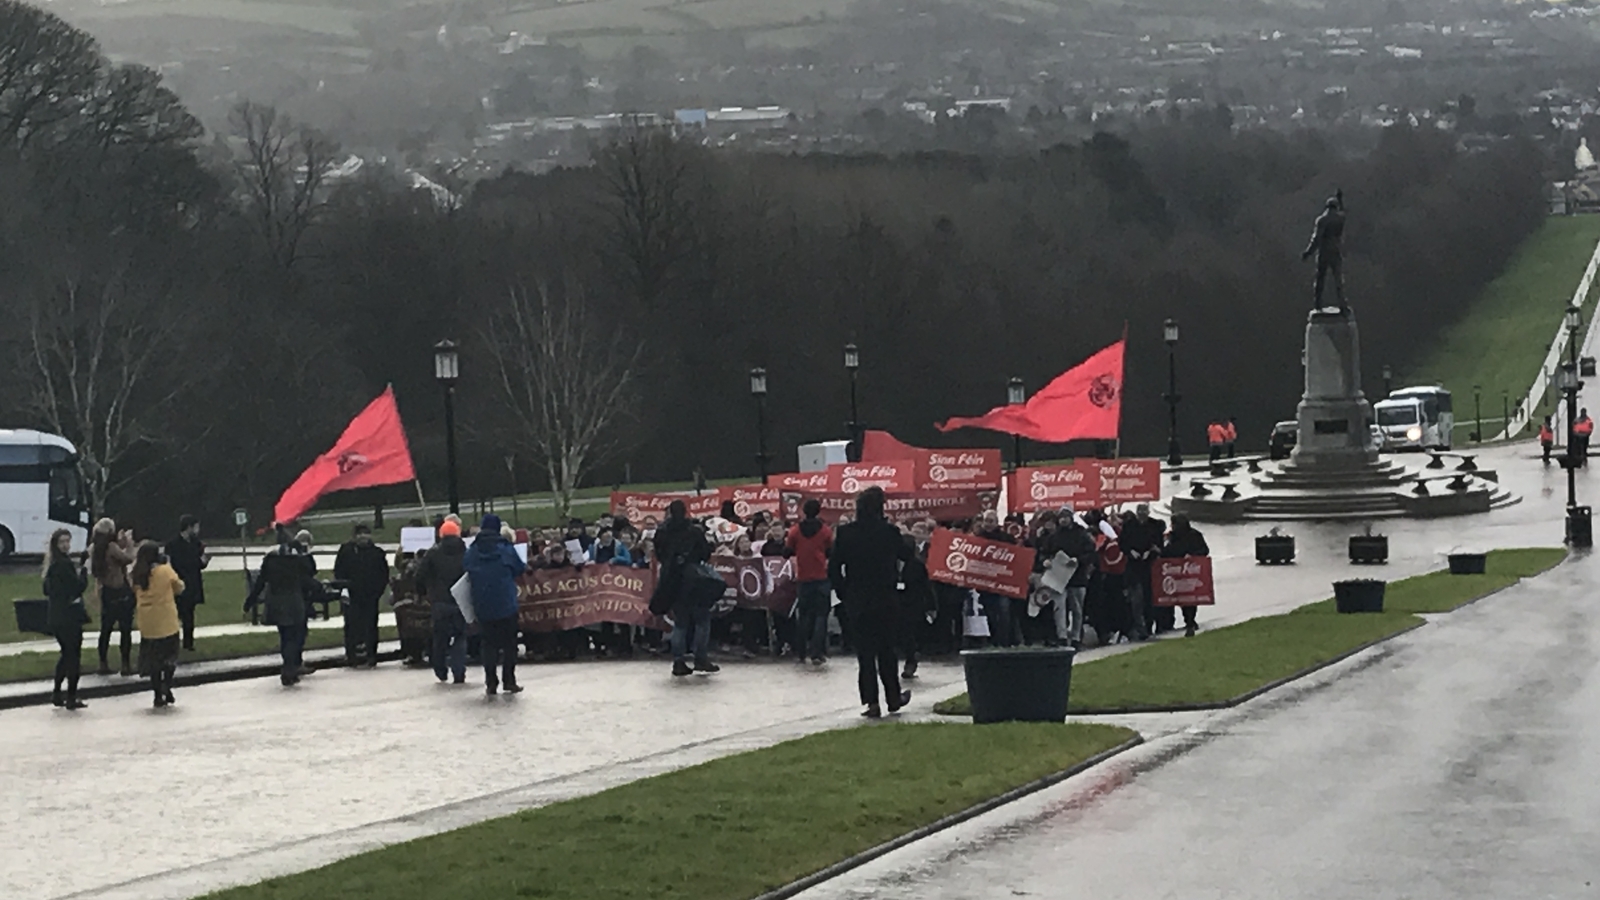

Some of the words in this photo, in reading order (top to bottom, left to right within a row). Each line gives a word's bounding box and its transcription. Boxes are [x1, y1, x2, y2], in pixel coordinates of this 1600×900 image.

[929, 453, 956, 465] Sinn
[957, 452, 984, 465] Féin
[842, 466, 868, 478] Sinn
[869, 465, 896, 477] Féin
[1030, 470, 1056, 483] Sinn
[1057, 469, 1084, 482] Féin
[809, 474, 828, 486] Féi
[732, 489, 758, 502] Sinn
[759, 487, 780, 500] Féi
[948, 537, 982, 555] Sinn
[982, 545, 1016, 563] Féin
[556, 577, 598, 593] AGUS
